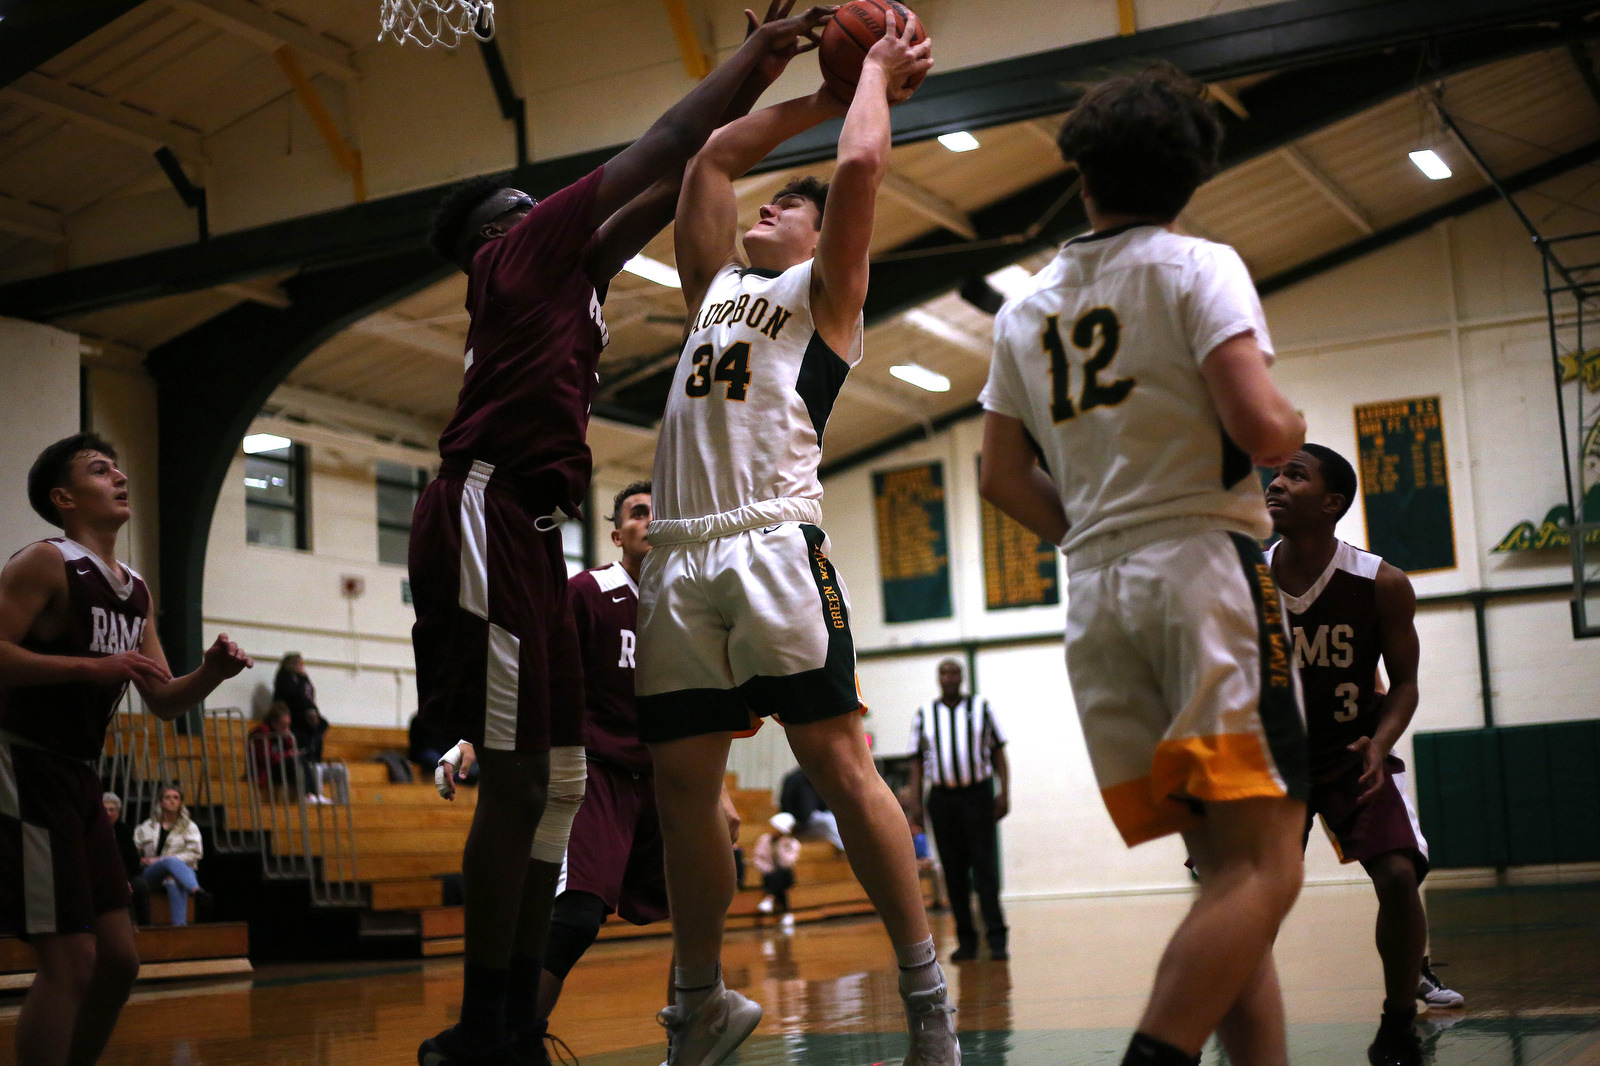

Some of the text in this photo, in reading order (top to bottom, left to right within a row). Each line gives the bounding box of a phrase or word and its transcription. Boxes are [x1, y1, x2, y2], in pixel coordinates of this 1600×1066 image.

[685, 340, 752, 402] 34
[1042, 305, 1137, 425] 12
[823, 586, 845, 629] GREEN
[1292, 624, 1354, 668] MS
[1333, 682, 1359, 723] 3
